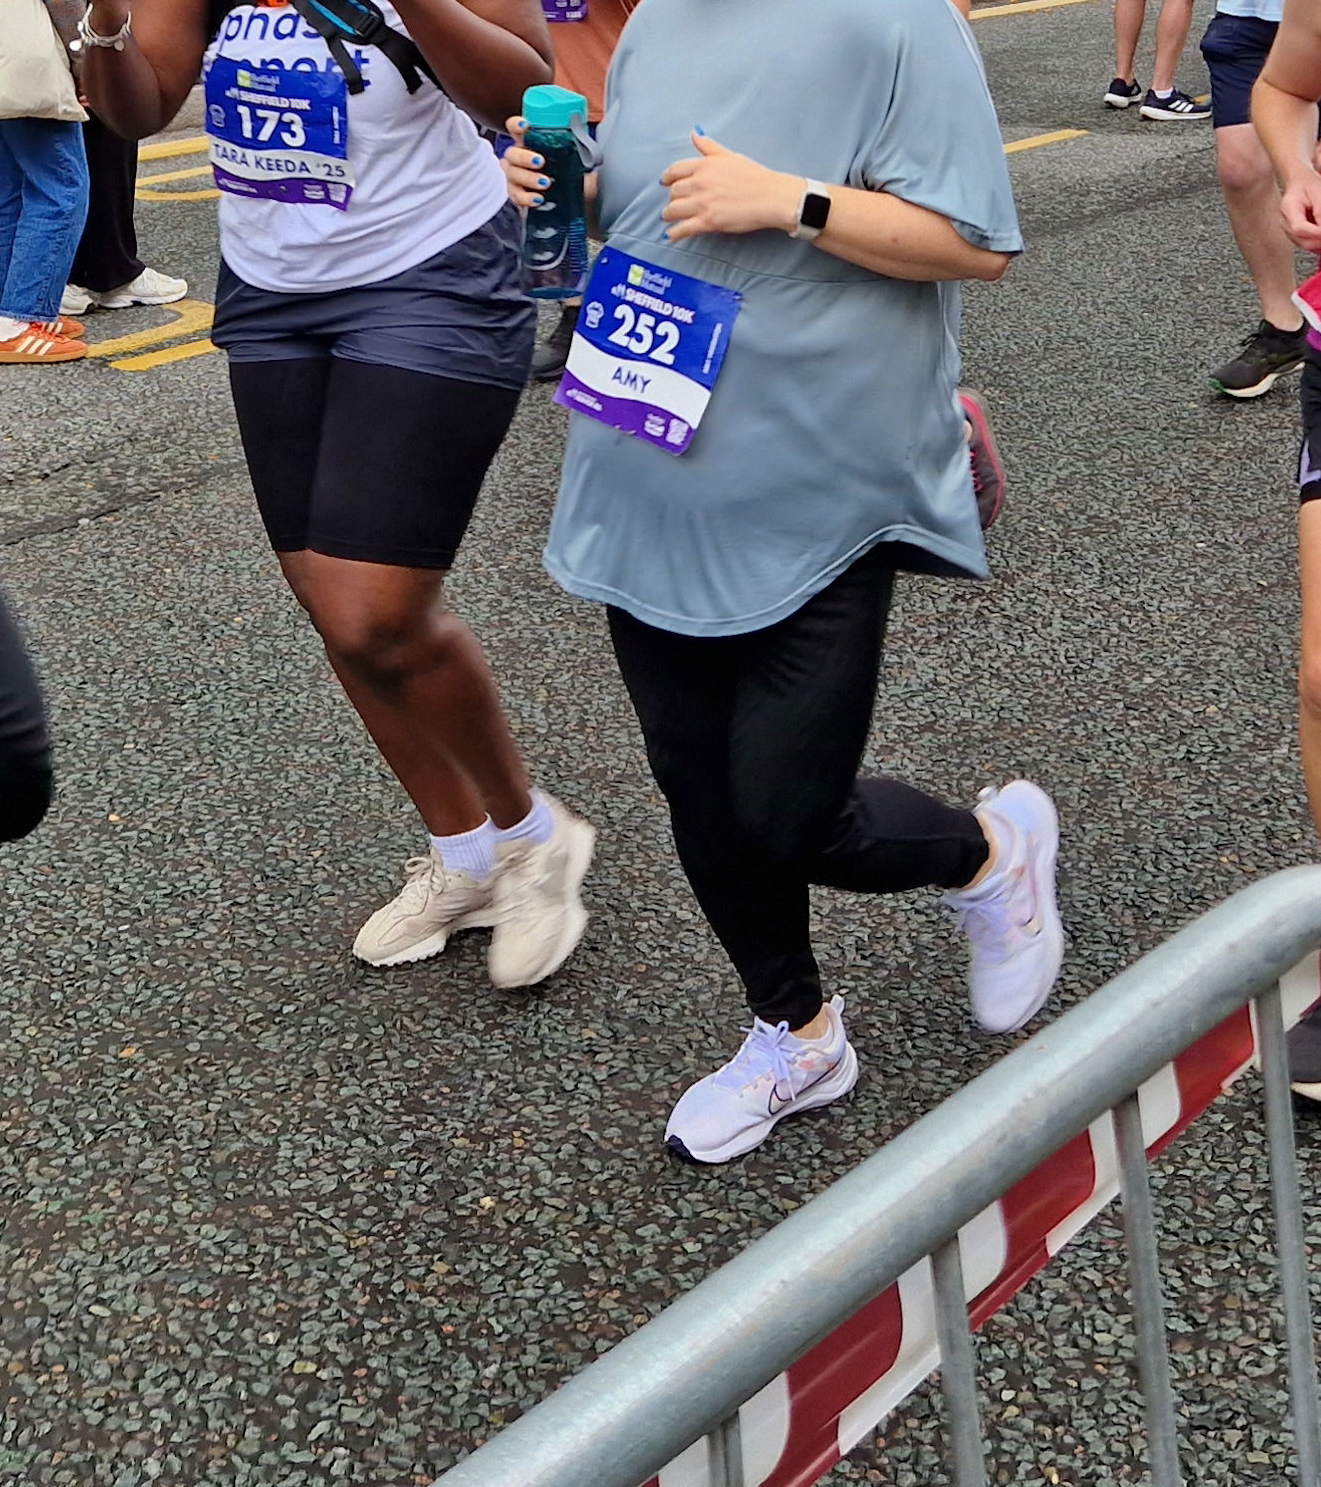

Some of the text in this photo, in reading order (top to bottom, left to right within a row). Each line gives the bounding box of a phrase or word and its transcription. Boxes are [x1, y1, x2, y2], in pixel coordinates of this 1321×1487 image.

[239, 90, 311, 111] SHEFFIELD 10K
[237, 105, 306, 148] 173
[213, 143, 249, 166] TARA
[254, 152, 311, 175] KEEDA
[624, 287, 696, 324] SHEFFIELD 10K
[608, 304, 680, 365] 252
[611, 366, 652, 394] AMY
